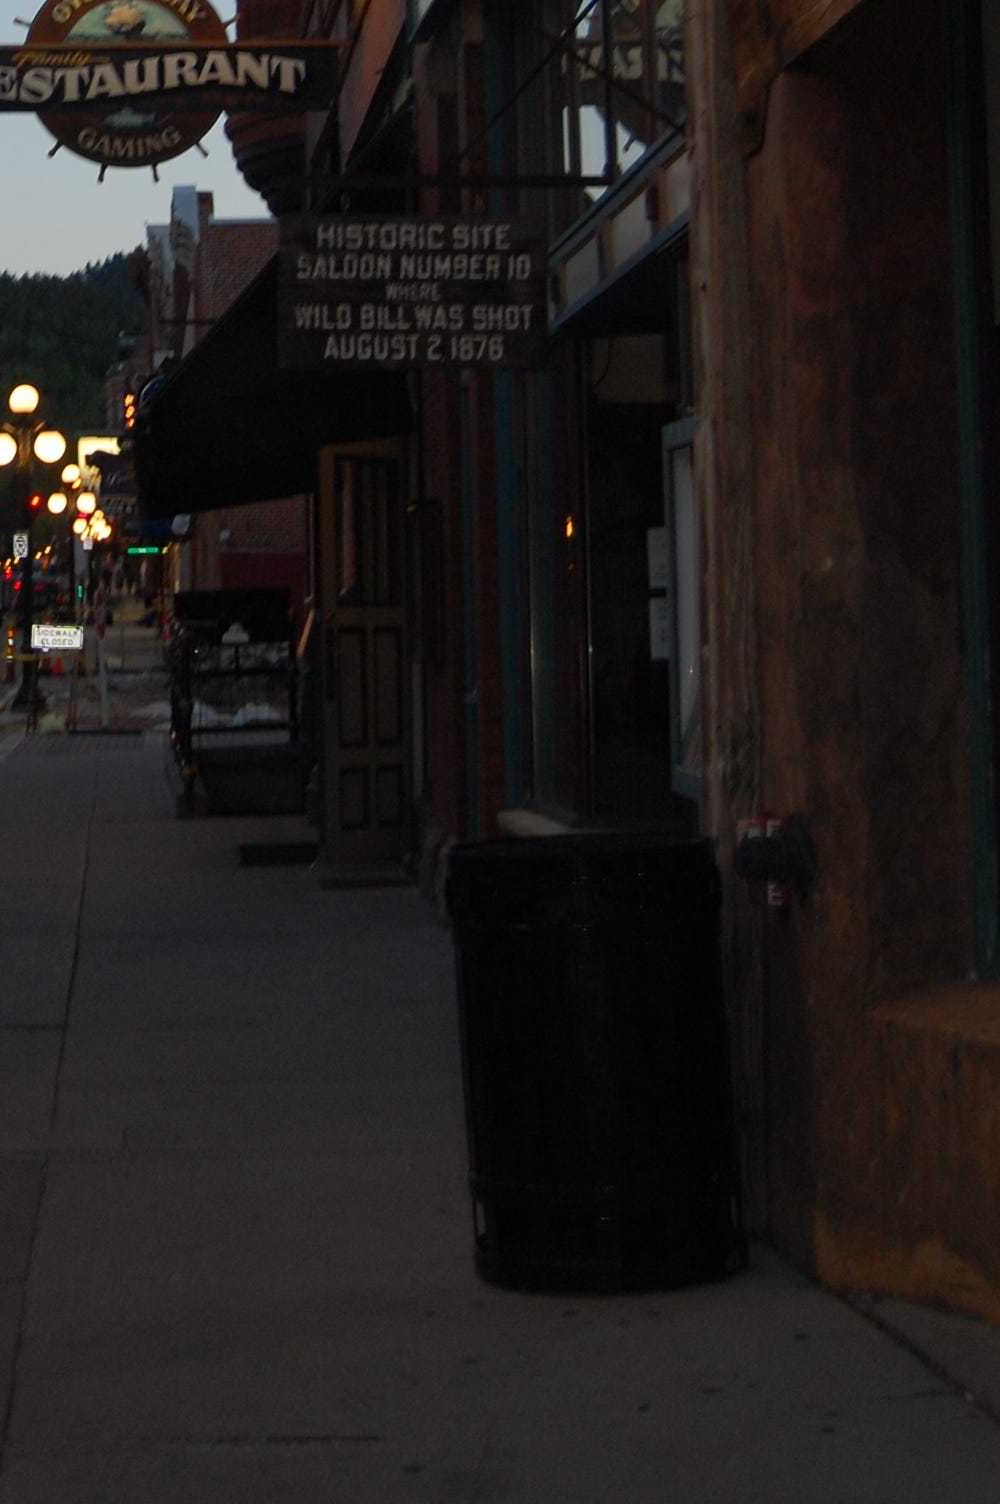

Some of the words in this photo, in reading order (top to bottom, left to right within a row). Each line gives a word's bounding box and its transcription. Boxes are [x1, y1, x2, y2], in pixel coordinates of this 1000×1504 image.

[76, 124, 182, 159] GAMING
[316, 222, 446, 251] HISTORIC
[452, 222, 512, 251] SITE
[296, 253, 392, 281] SALOON
[399, 253, 502, 281] NUMBER
[507, 253, 532, 281] 10
[385, 281, 442, 302] WHERE
[295, 303, 351, 330] WILD
[360, 303, 412, 330] BILL
[413, 303, 464, 331] WAS
[471, 303, 535, 331] SHOT
[323, 333, 421, 361] AUGUST
[37, 629, 78, 637] SIDEWALK
